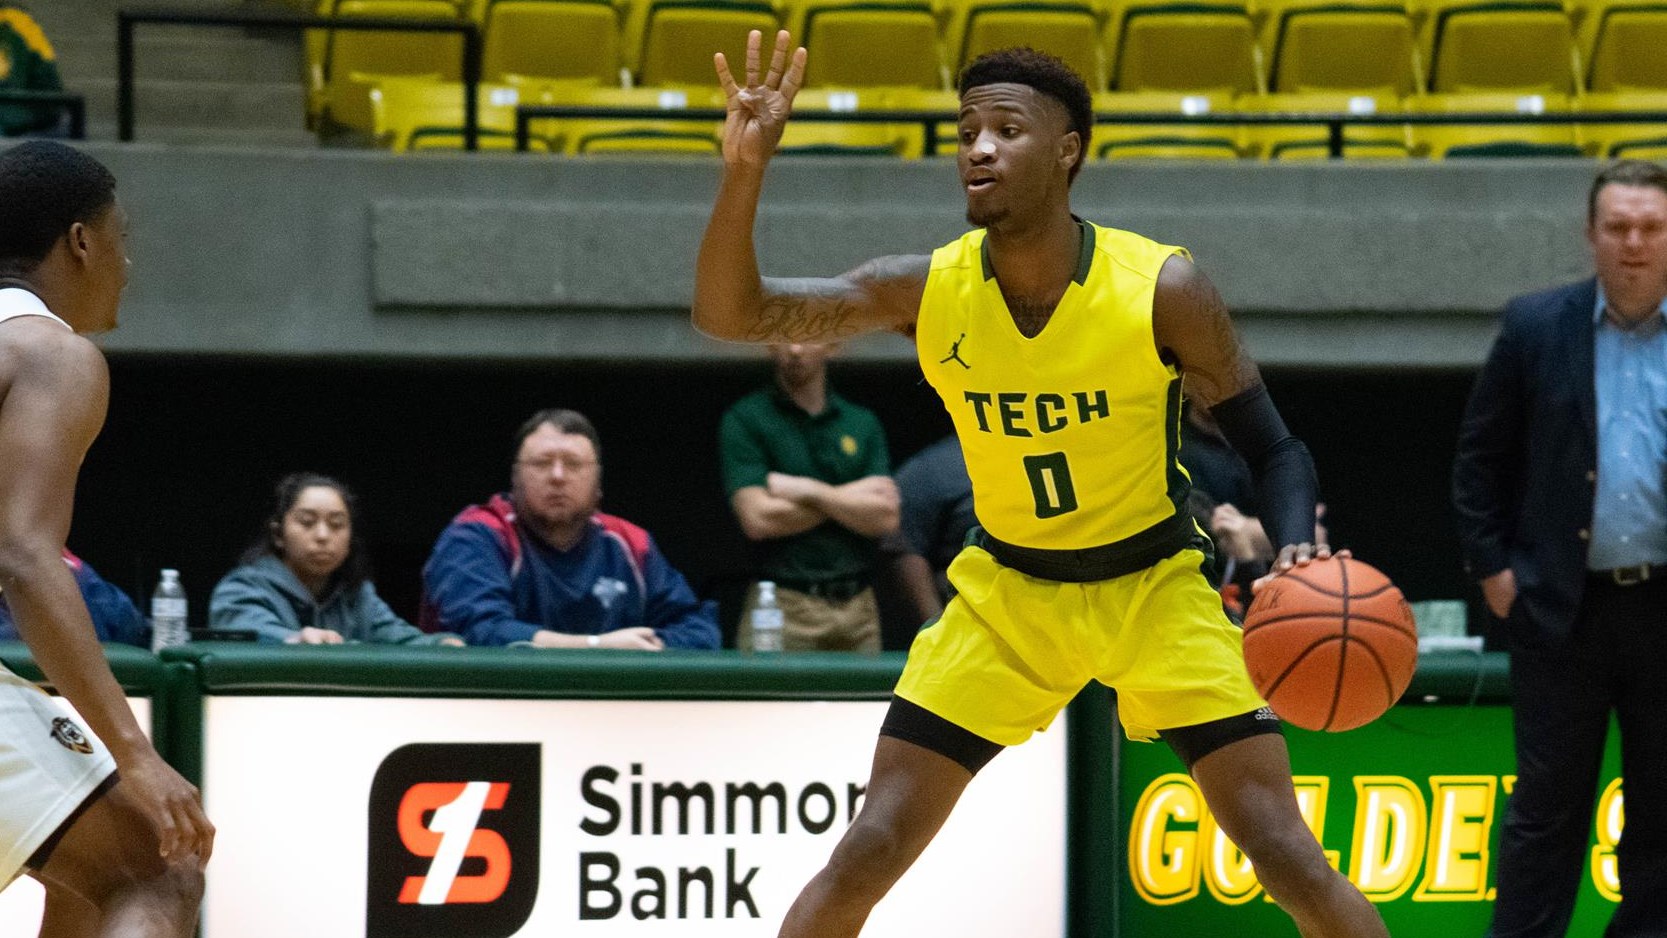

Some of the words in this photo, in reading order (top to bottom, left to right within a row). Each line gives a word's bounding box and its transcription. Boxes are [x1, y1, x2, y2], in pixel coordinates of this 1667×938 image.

[963, 389, 1110, 438] TECH
[1022, 451, 1079, 520] 0
[578, 847, 761, 921] Bank
